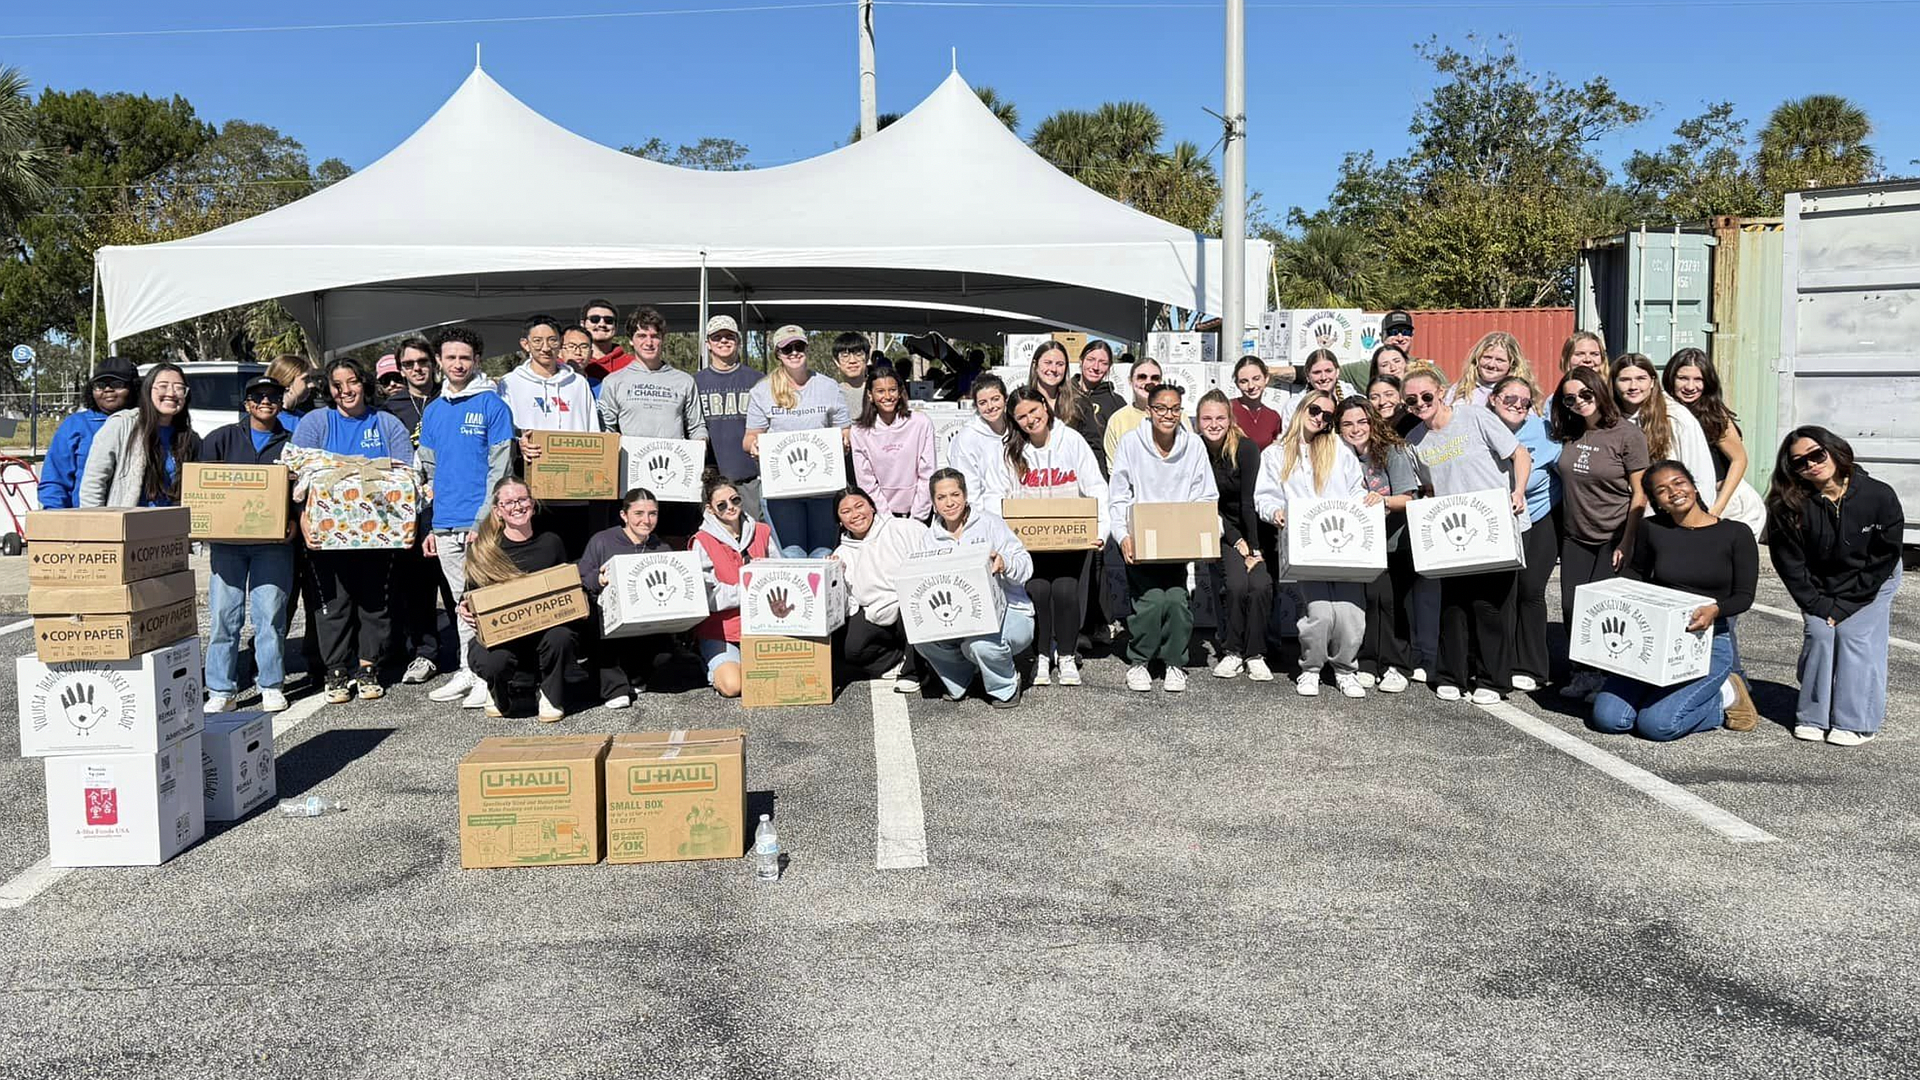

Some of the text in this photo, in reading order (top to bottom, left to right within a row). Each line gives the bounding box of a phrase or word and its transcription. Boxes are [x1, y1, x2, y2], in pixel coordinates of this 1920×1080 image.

[634, 390, 672, 398] CHARLES
[786, 407, 816, 416] Region
[551, 438, 601, 448] U-HAUL
[204, 471, 264, 481] U-HAUL
[183, 492, 226, 500] SMALL BOX
[1021, 524, 1087, 536] COPY PAPER
[137, 541, 184, 562] COPY PAPER
[42, 553, 117, 564] COPY PAPER
[500, 594, 573, 625] COPY PAPER
[146, 605, 192, 632] COPY PAPER
[50, 629, 124, 641] COPY PAPER
[759, 642, 811, 652] U-HAUL
[35, 660, 98, 692] THANKSGIVING
[100, 664, 130, 693] BASKET
[31, 694, 48, 732] VOLUSIA
[486, 771, 566, 787] U-HAUL
[634, 767, 713, 784] U-HAUL
[609, 799, 664, 811] SMALL BOX
[624, 840, 644, 850] OK
